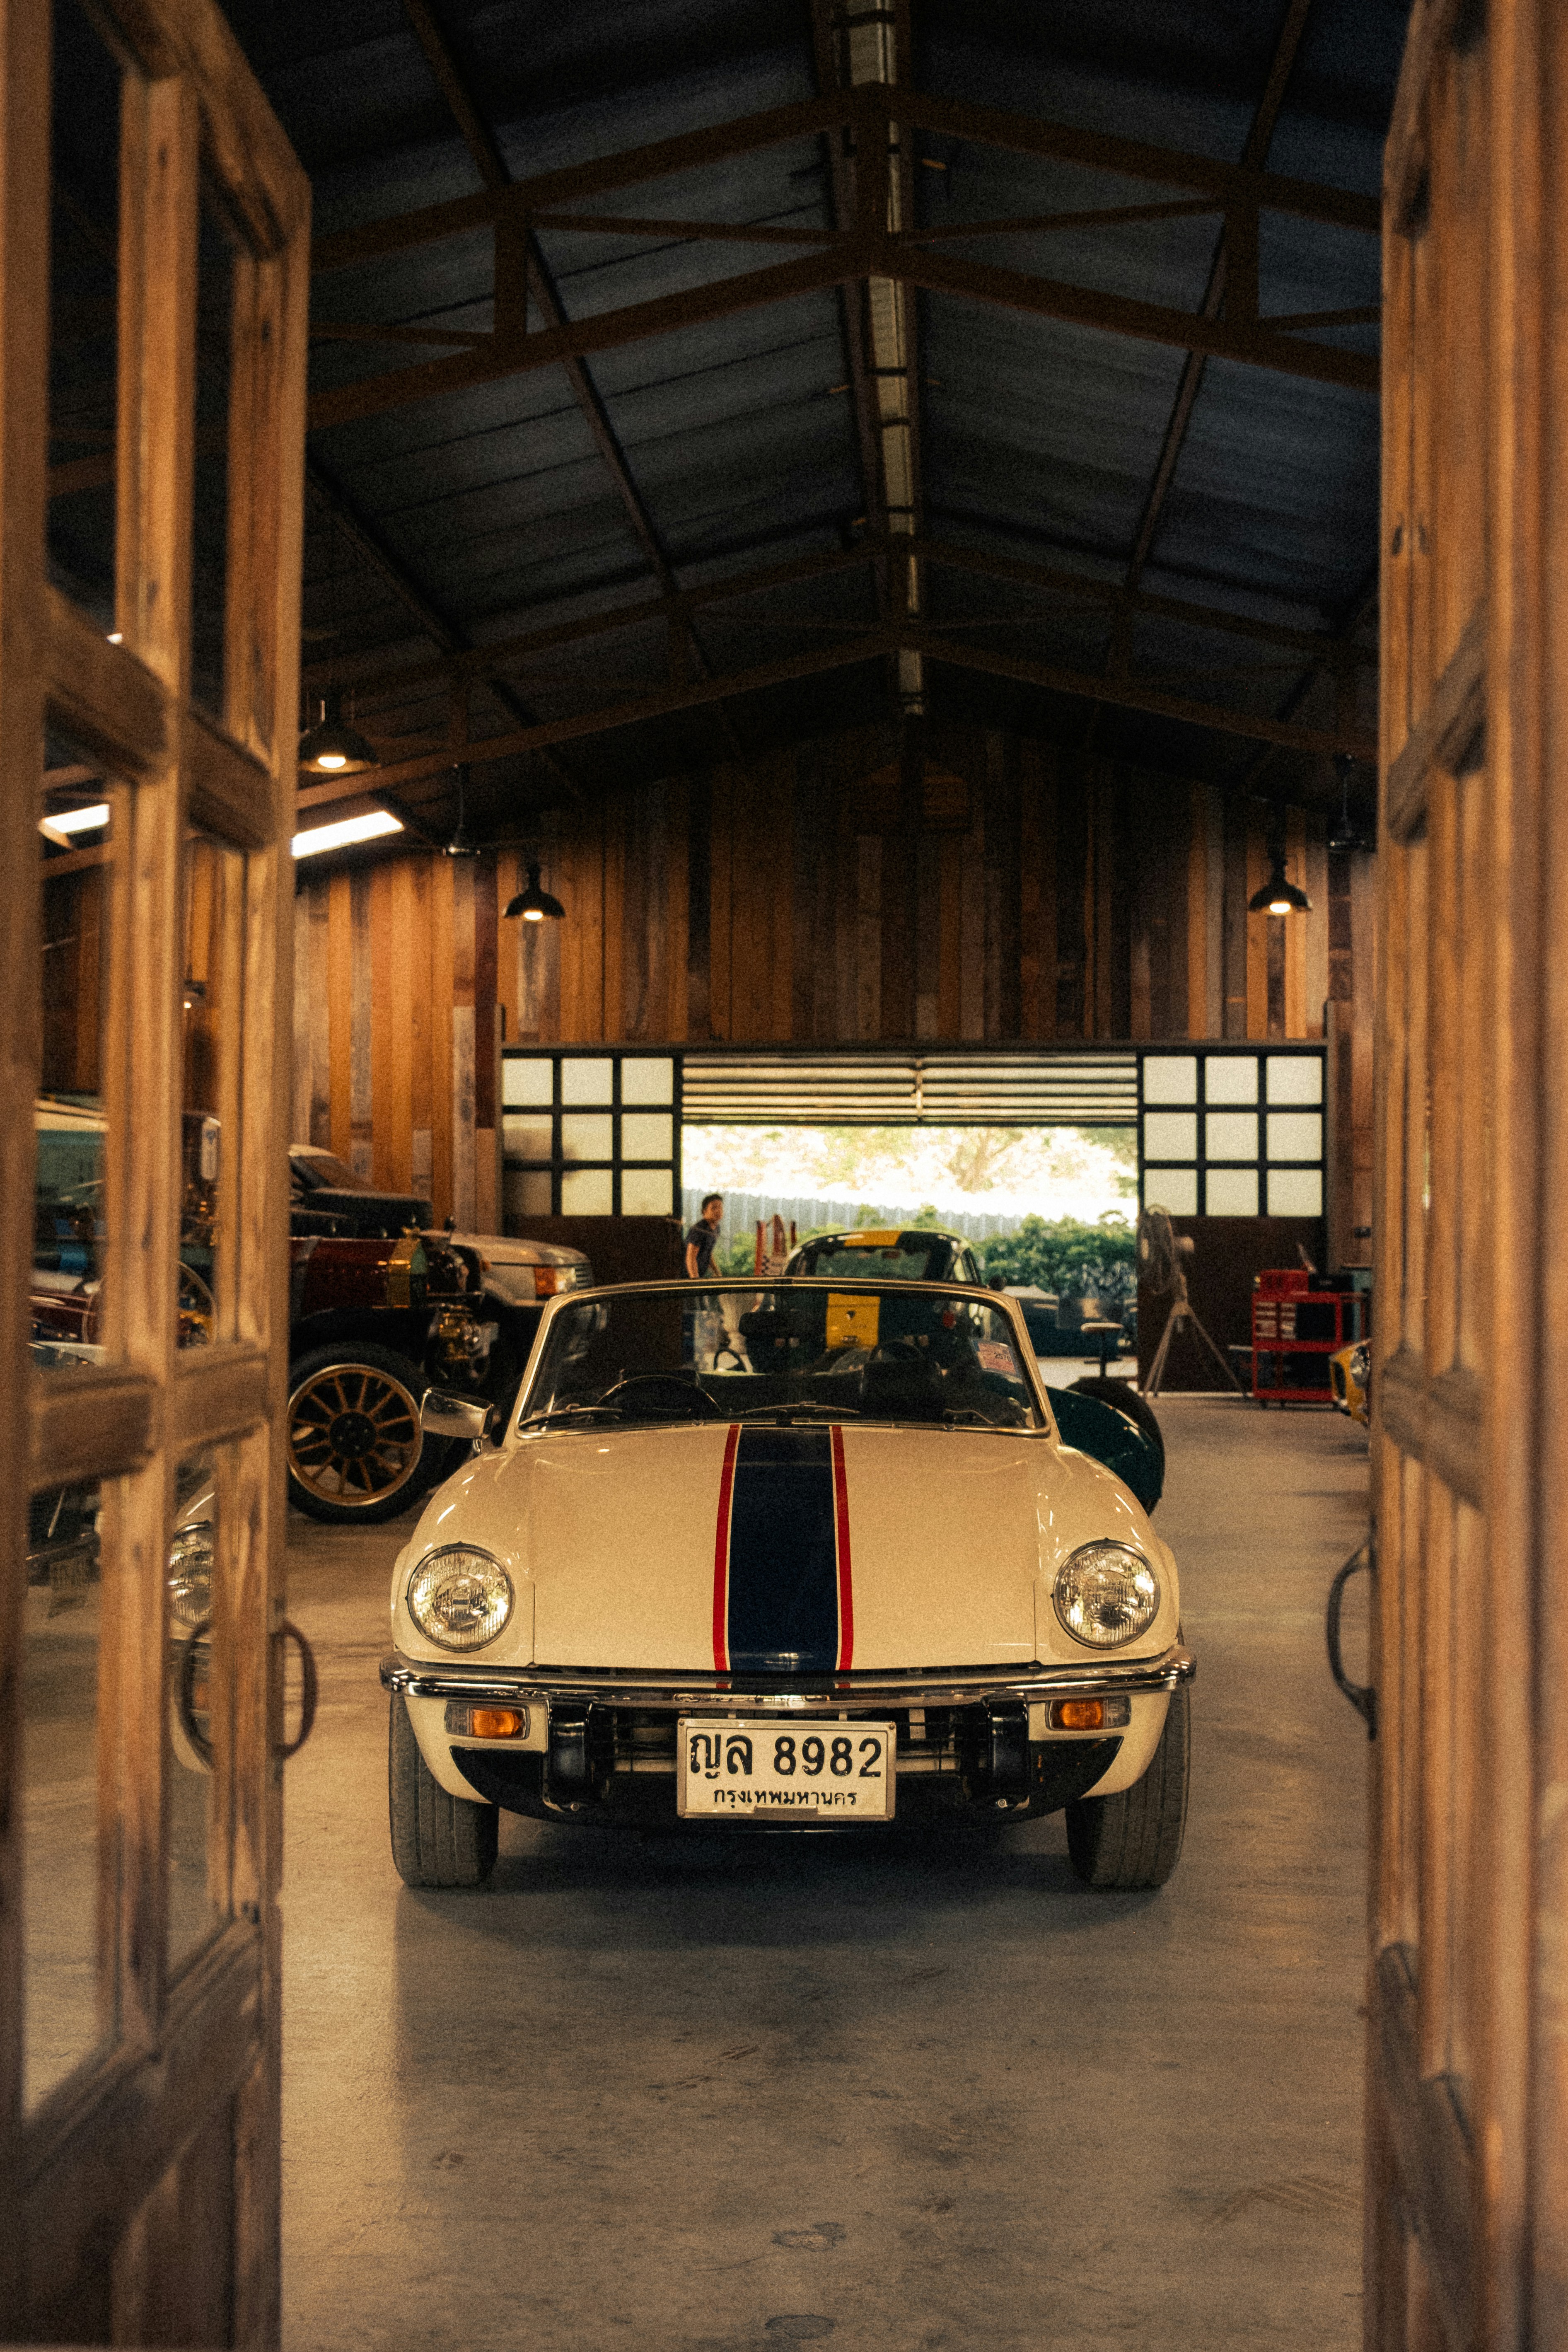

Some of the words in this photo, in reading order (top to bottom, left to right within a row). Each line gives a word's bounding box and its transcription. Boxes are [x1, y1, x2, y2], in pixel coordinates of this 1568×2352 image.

[690, 1734, 753, 1779] ญล
[773, 1736, 882, 1777] 8982
[714, 1789, 857, 1808] กรุงเทพมหานคร
